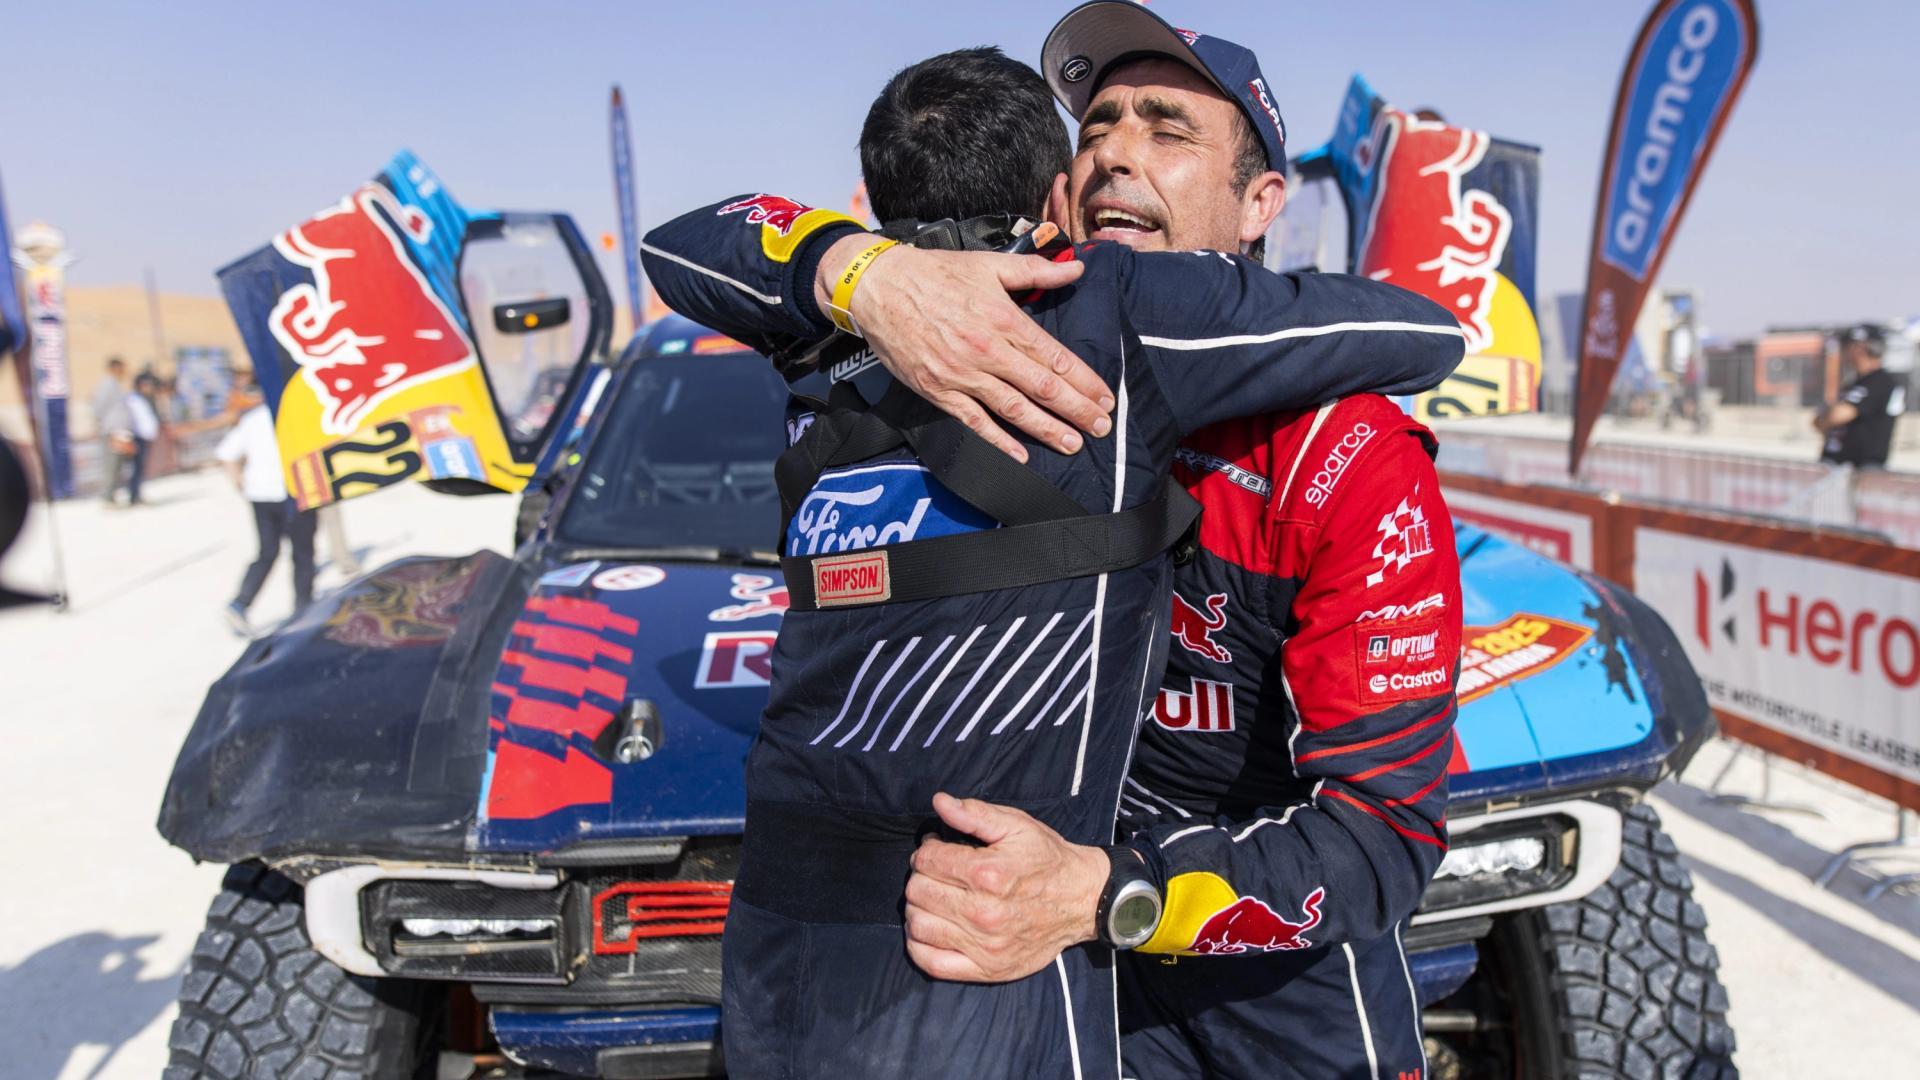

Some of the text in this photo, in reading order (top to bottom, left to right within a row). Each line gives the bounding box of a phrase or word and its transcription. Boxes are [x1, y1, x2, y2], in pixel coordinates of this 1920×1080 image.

[1614, 2, 1720, 254] aramco
[1304, 422, 1372, 505] sparco
[820, 564, 880, 593] SIMPSON
[1355, 592, 1446, 622] MMR
[1389, 665, 1447, 691] Castrol
[1150, 676, 1236, 733] ull
